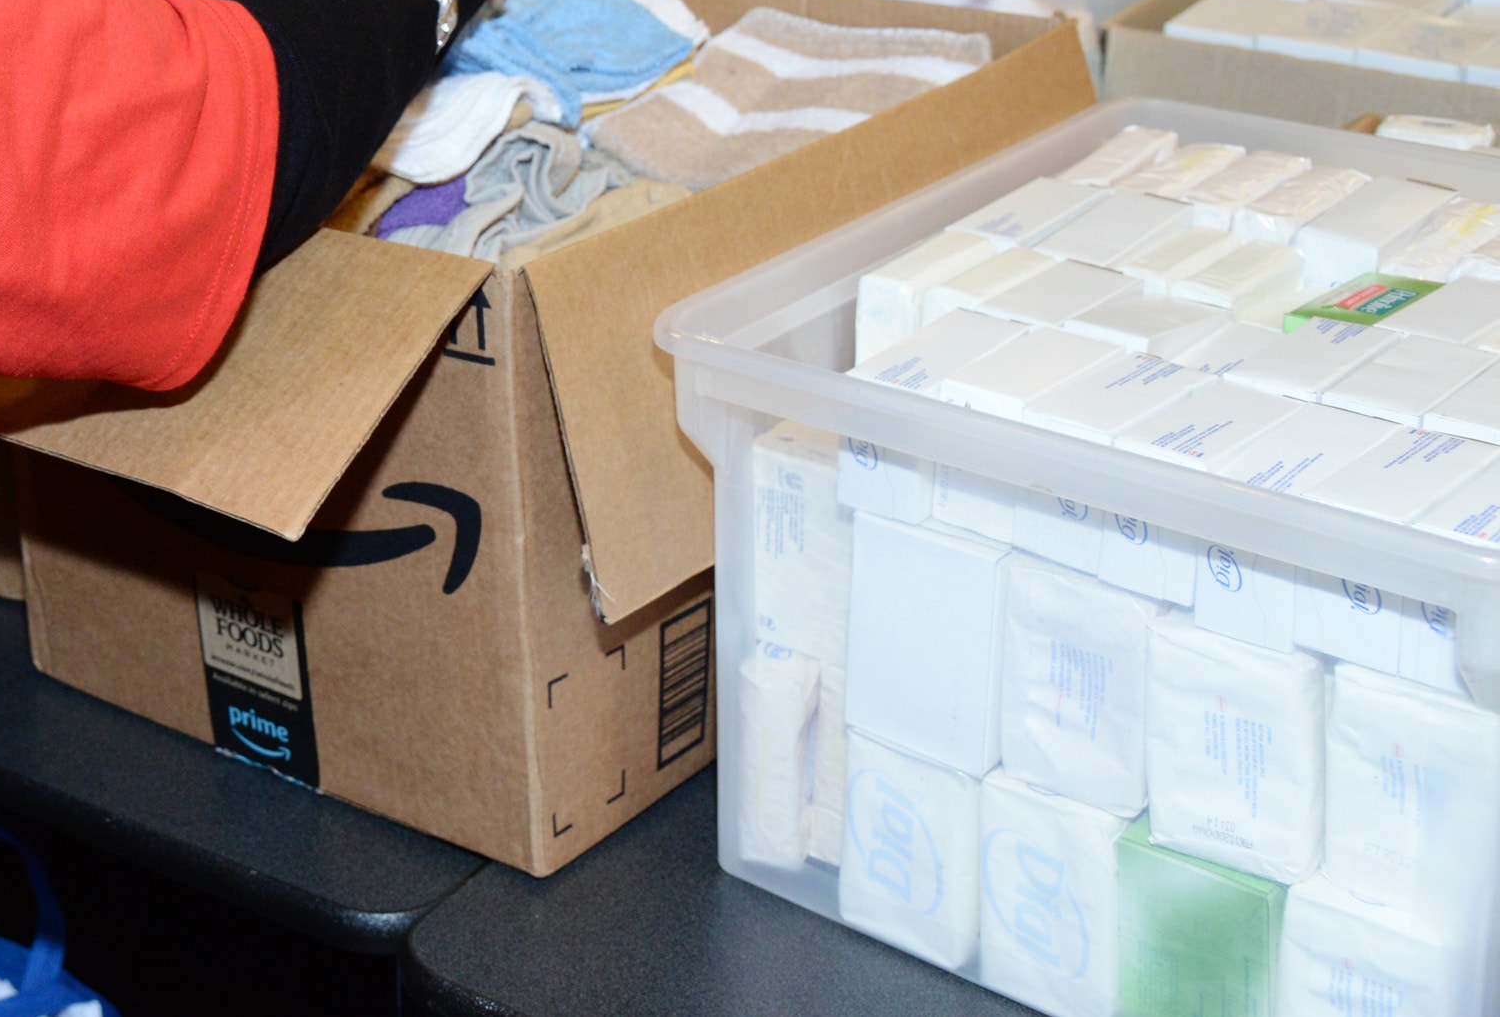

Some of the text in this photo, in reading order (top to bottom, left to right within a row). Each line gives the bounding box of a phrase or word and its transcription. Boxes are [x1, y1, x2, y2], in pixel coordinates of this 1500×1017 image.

[1215, 548, 1231, 589] Dial
[209, 595, 284, 638] WHOLE
[216, 615, 285, 659] FOODS
[227, 704, 290, 744] prime
[867, 776, 918, 904] Dial
[1014, 838, 1065, 970] Dial
